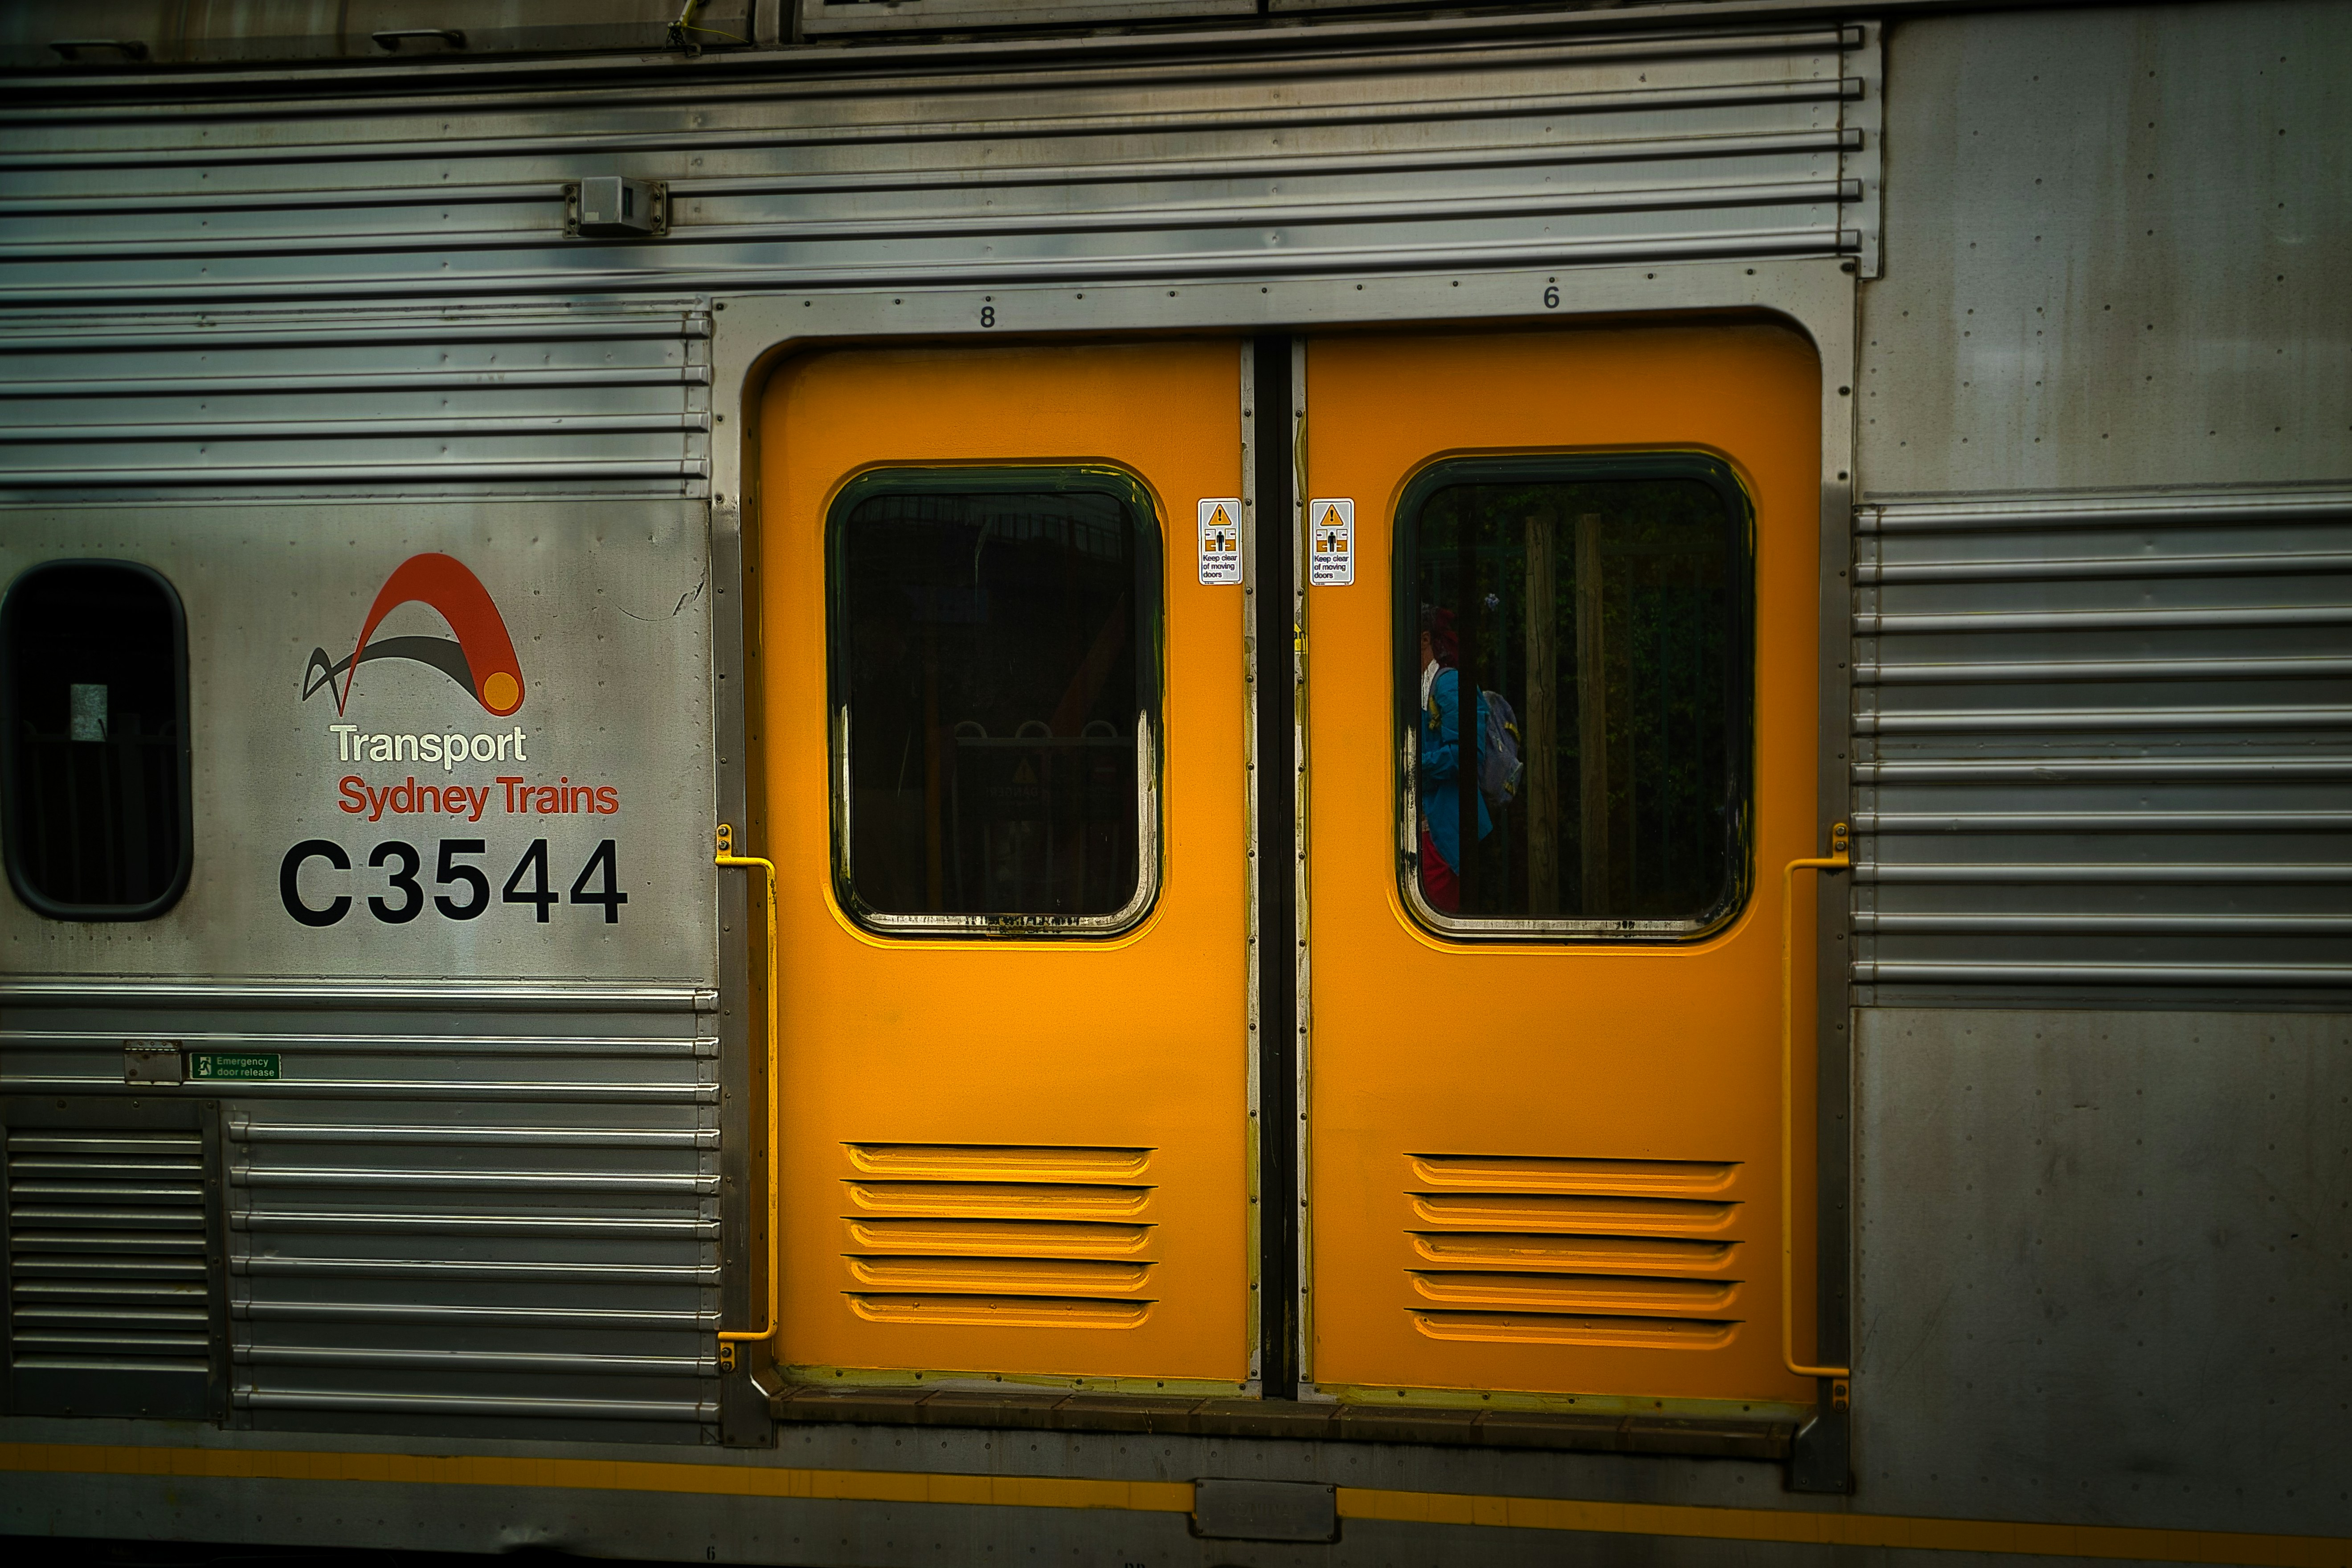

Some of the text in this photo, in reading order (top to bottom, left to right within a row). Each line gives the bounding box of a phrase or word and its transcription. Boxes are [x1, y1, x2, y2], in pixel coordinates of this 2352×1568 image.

[1544, 286, 1559, 309] 6
[981, 306, 995, 328] 8
[1203, 554, 1220, 563] Keep
[1314, 555, 1331, 563] Keep
[1211, 562, 1235, 571] moving
[1322, 563, 1346, 572] moving
[330, 724, 527, 770] Transport
[339, 775, 619, 822] Sydney Trains
[279, 838, 628, 927] C3544
[217, 1057, 269, 1067] Emergency
[241, 1068, 274, 1077] release
[707, 1546, 715, 1560] 6
